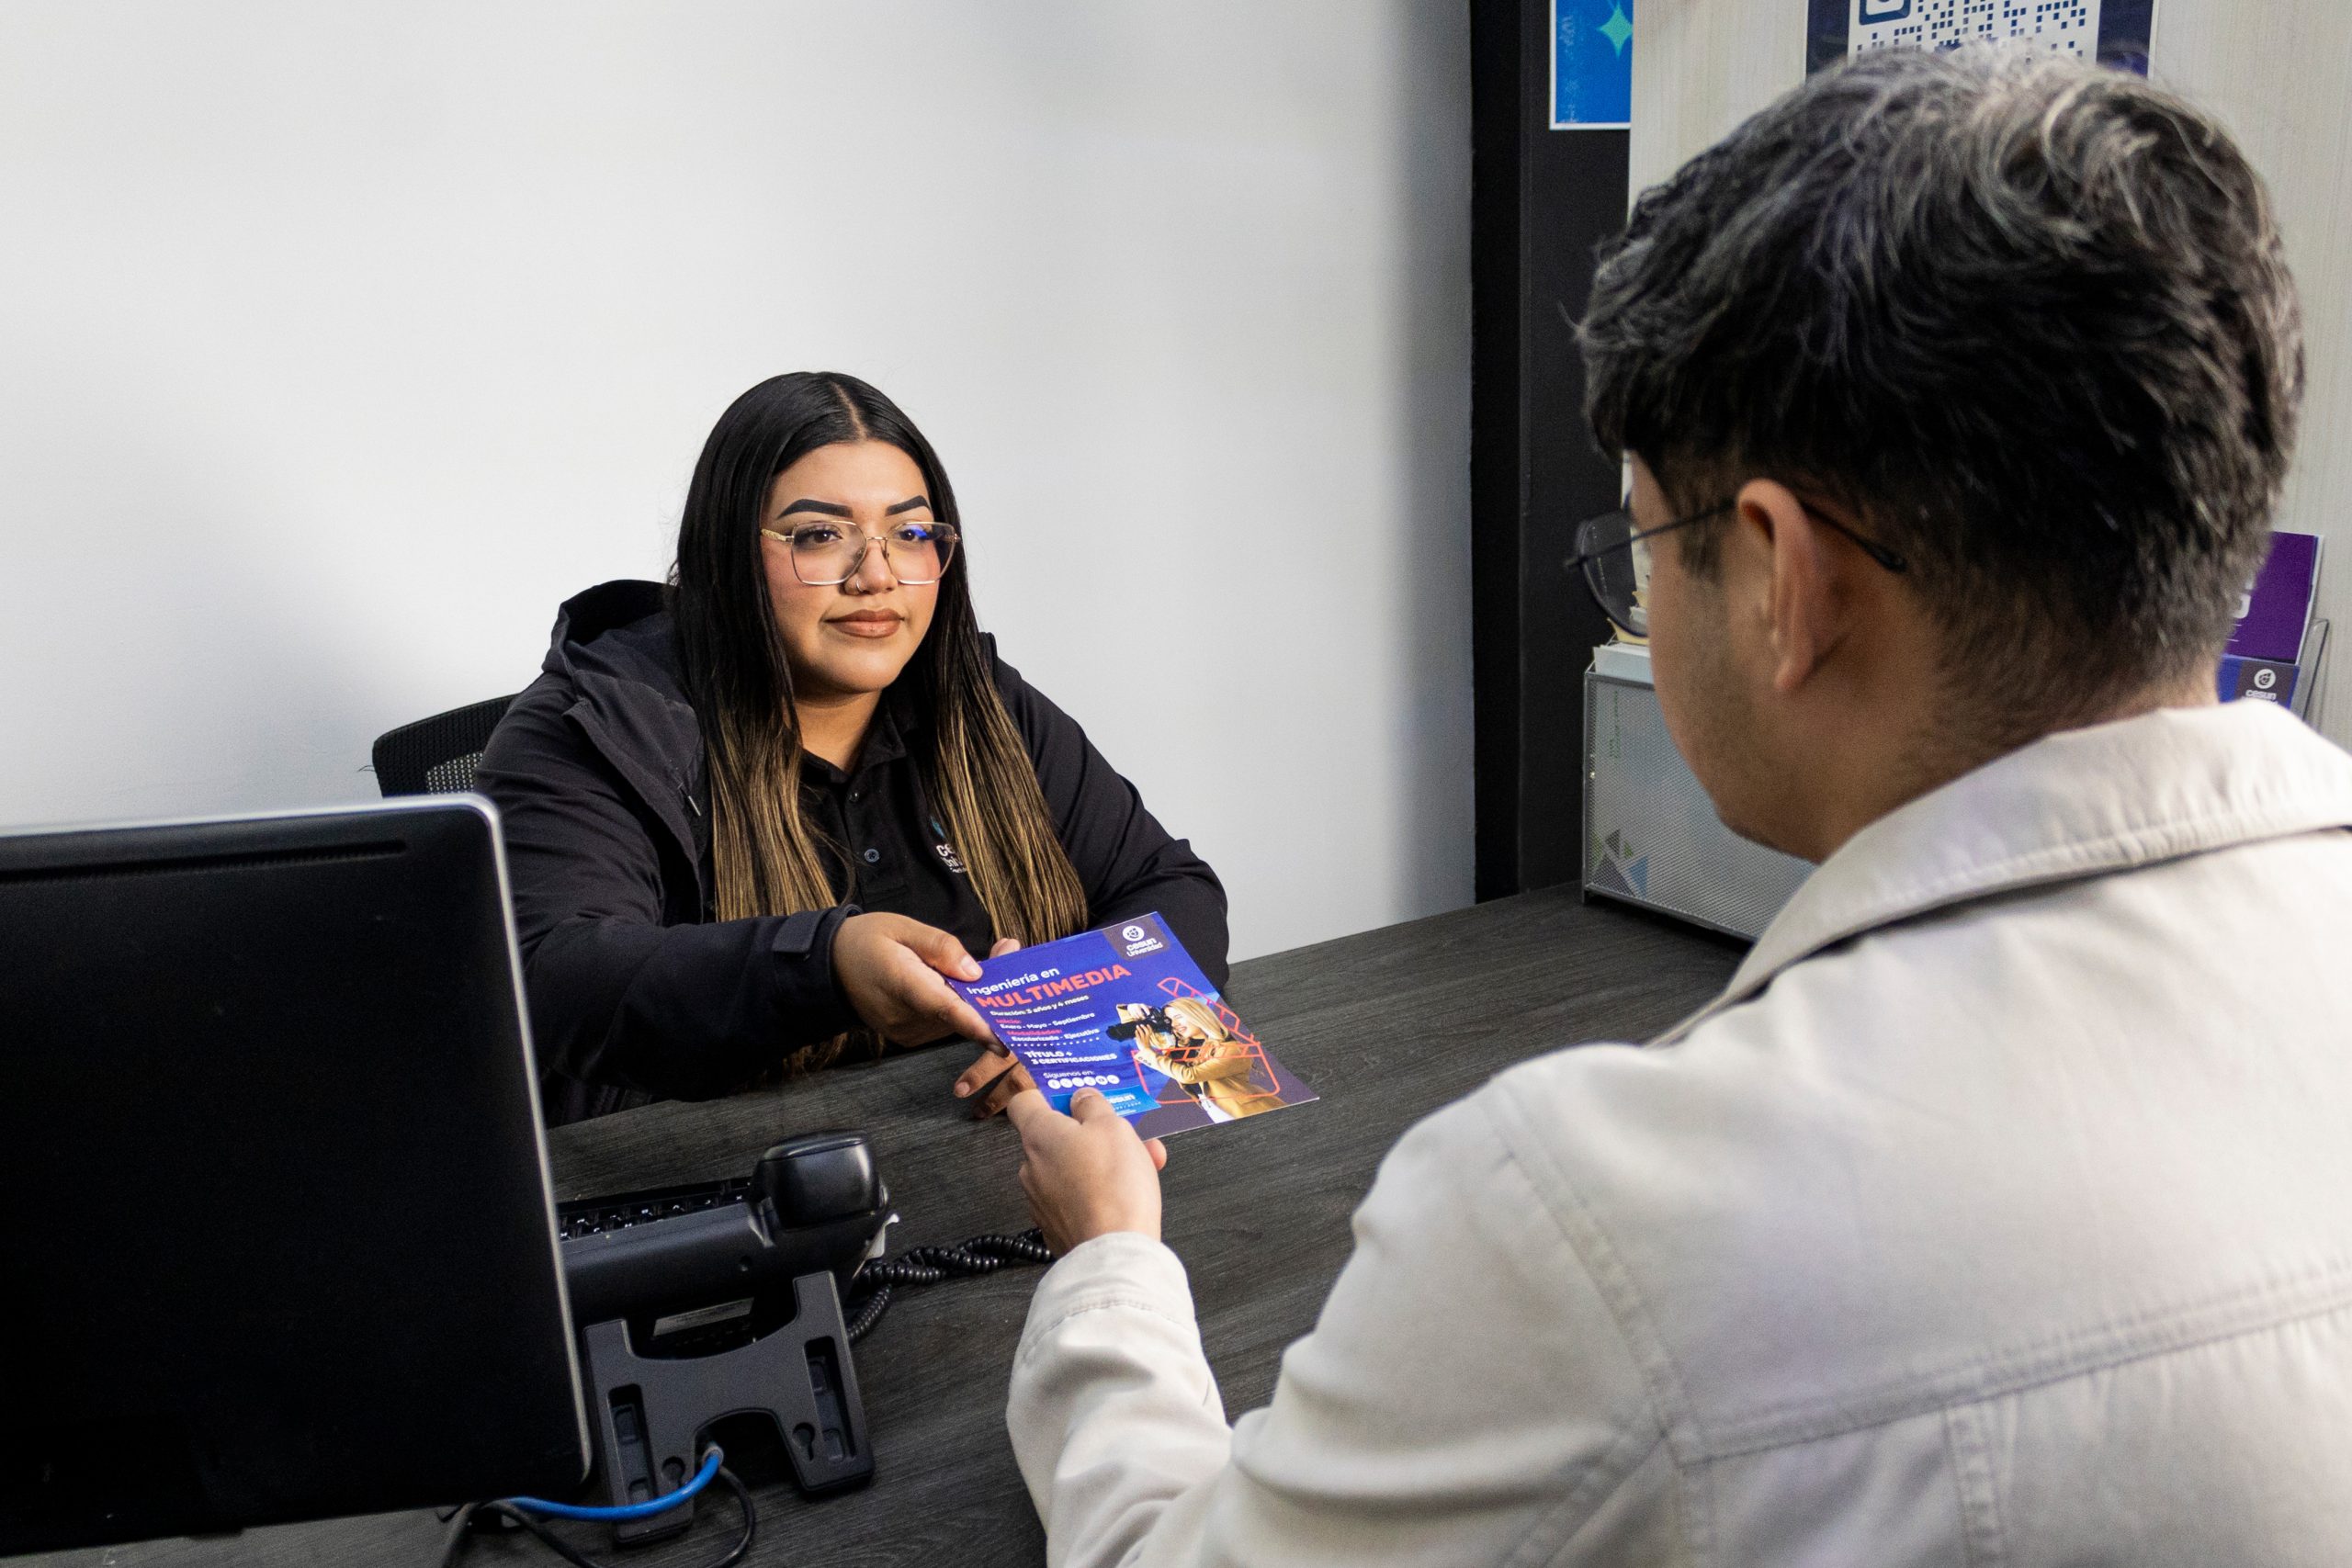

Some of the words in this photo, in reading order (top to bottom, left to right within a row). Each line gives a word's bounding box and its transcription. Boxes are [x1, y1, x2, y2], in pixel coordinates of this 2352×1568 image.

[1126, 942, 1163, 956] Universidad
[967, 973, 1038, 996] Ingeniería
[1040, 967, 1059, 979] en
[975, 964, 1131, 1008] MULTIMEDIA
[1064, 995, 1089, 1006] meses
[1052, 1012, 1095, 1026] Septiembre
[1038, 1053, 1117, 1065] CERTIFICACIONES
